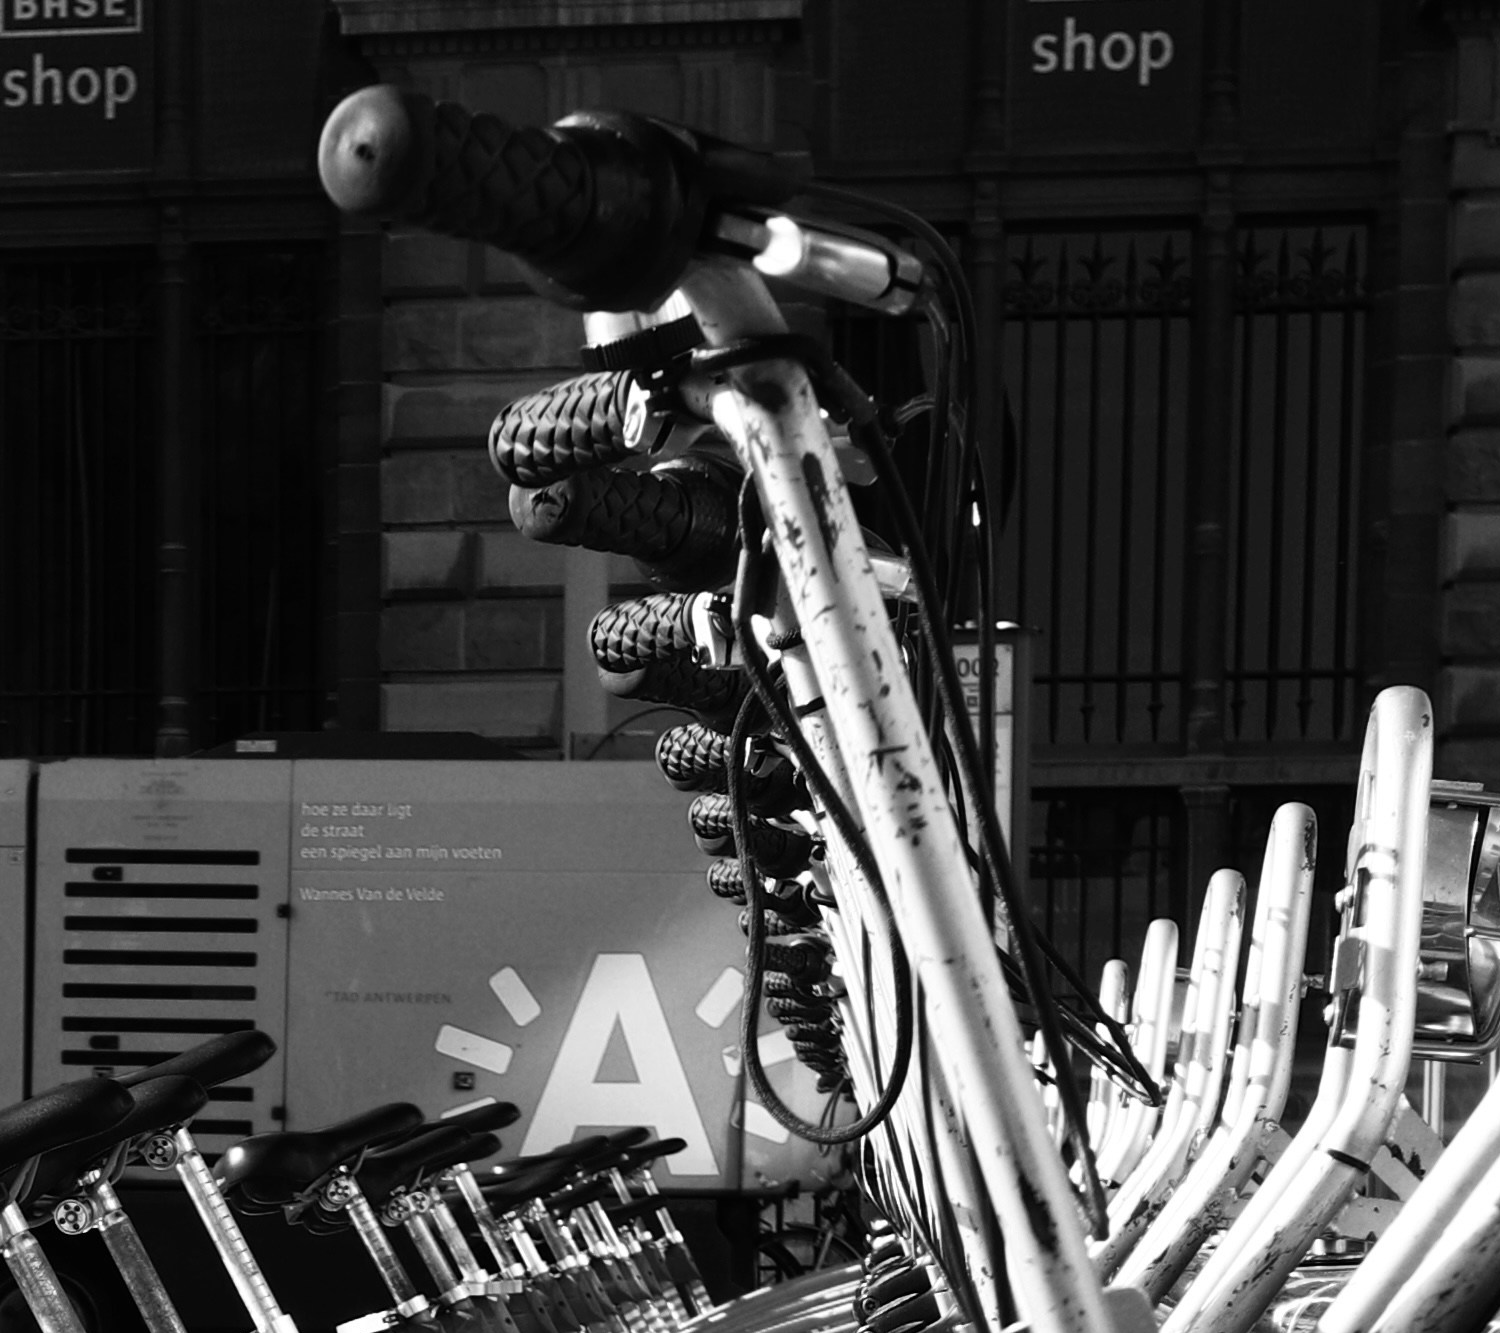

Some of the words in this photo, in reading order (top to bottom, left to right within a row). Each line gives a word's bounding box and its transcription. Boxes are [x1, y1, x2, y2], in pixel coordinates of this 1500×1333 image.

[1031, 17, 1175, 86] shop
[3, 53, 138, 120] shop
[301, 802, 329, 817] hoe
[332, 804, 348, 817] ze
[351, 802, 384, 817] daar
[387, 802, 412, 820] ligt
[300, 823, 319, 838] de
[322, 824, 365, 838] straat
[300, 847, 327, 860] een
[330, 845, 382, 862] spiegel
[386, 847, 412, 859] aan
[416, 845, 448, 862] mijn
[452, 845, 502, 860] voeten
[300, 888, 353, 901] Wannes
[356, 888, 383, 901] Van
[386, 887, 403, 901] de
[406, 887, 445, 901] Velde
[363, 992, 453, 1004] ANTWERPEN
